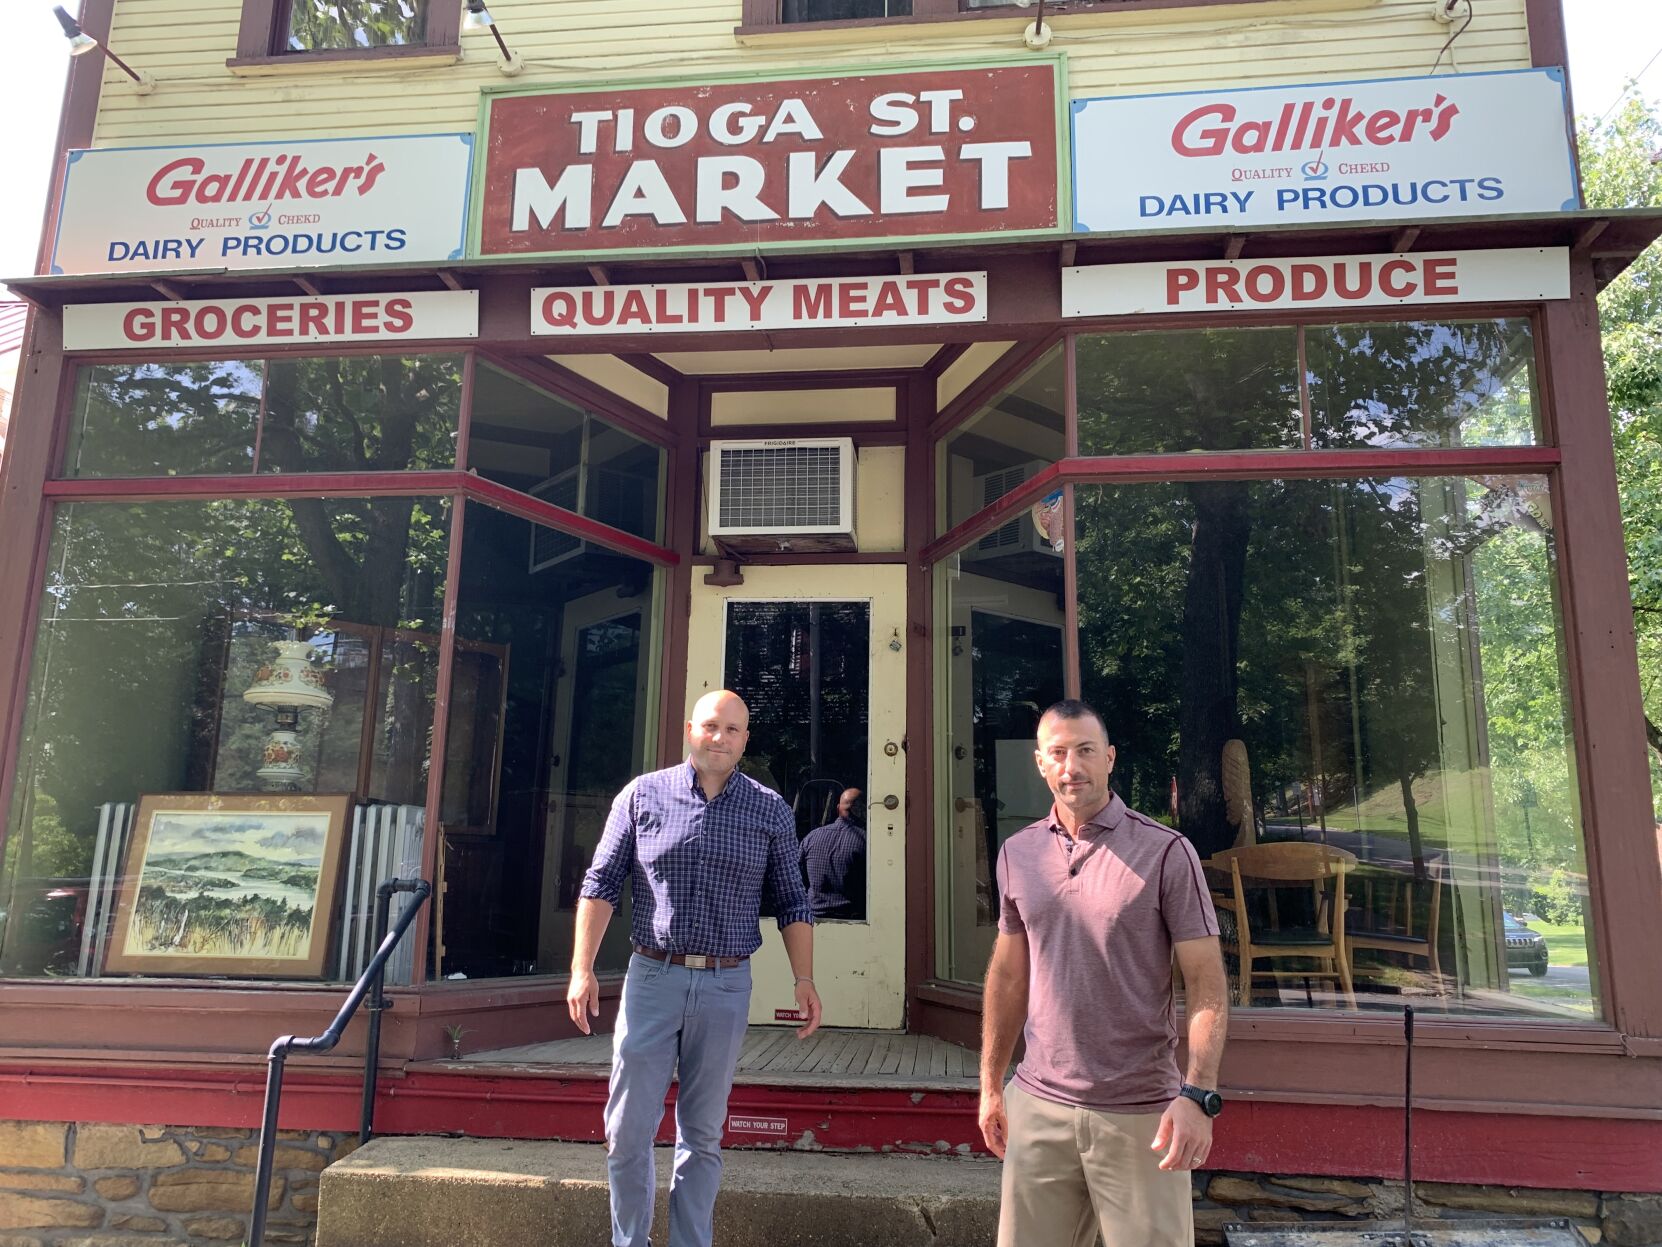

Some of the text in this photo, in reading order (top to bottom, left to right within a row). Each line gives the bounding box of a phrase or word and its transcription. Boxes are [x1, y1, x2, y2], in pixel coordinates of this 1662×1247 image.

[570, 89, 977, 154] TIOGA ST.
[1171, 92, 1460, 157] Galliker's
[146, 152, 386, 206] Galliker's
[511, 140, 1032, 232] MARKET
[1231, 162, 1390, 182] QUALITY CHEKD
[1139, 176, 1505, 218] DAIRY PRODUCTS
[189, 214, 321, 230] QUALITY CHEKD
[107, 229, 407, 262] DAIRY PRODUCTS
[541, 276, 977, 330] QUALITY MEATS
[1166, 257, 1459, 305] PRODUCE
[123, 298, 414, 341] GROCERIES
[731, 1120, 786, 1130] WATCH YOUR STEP
